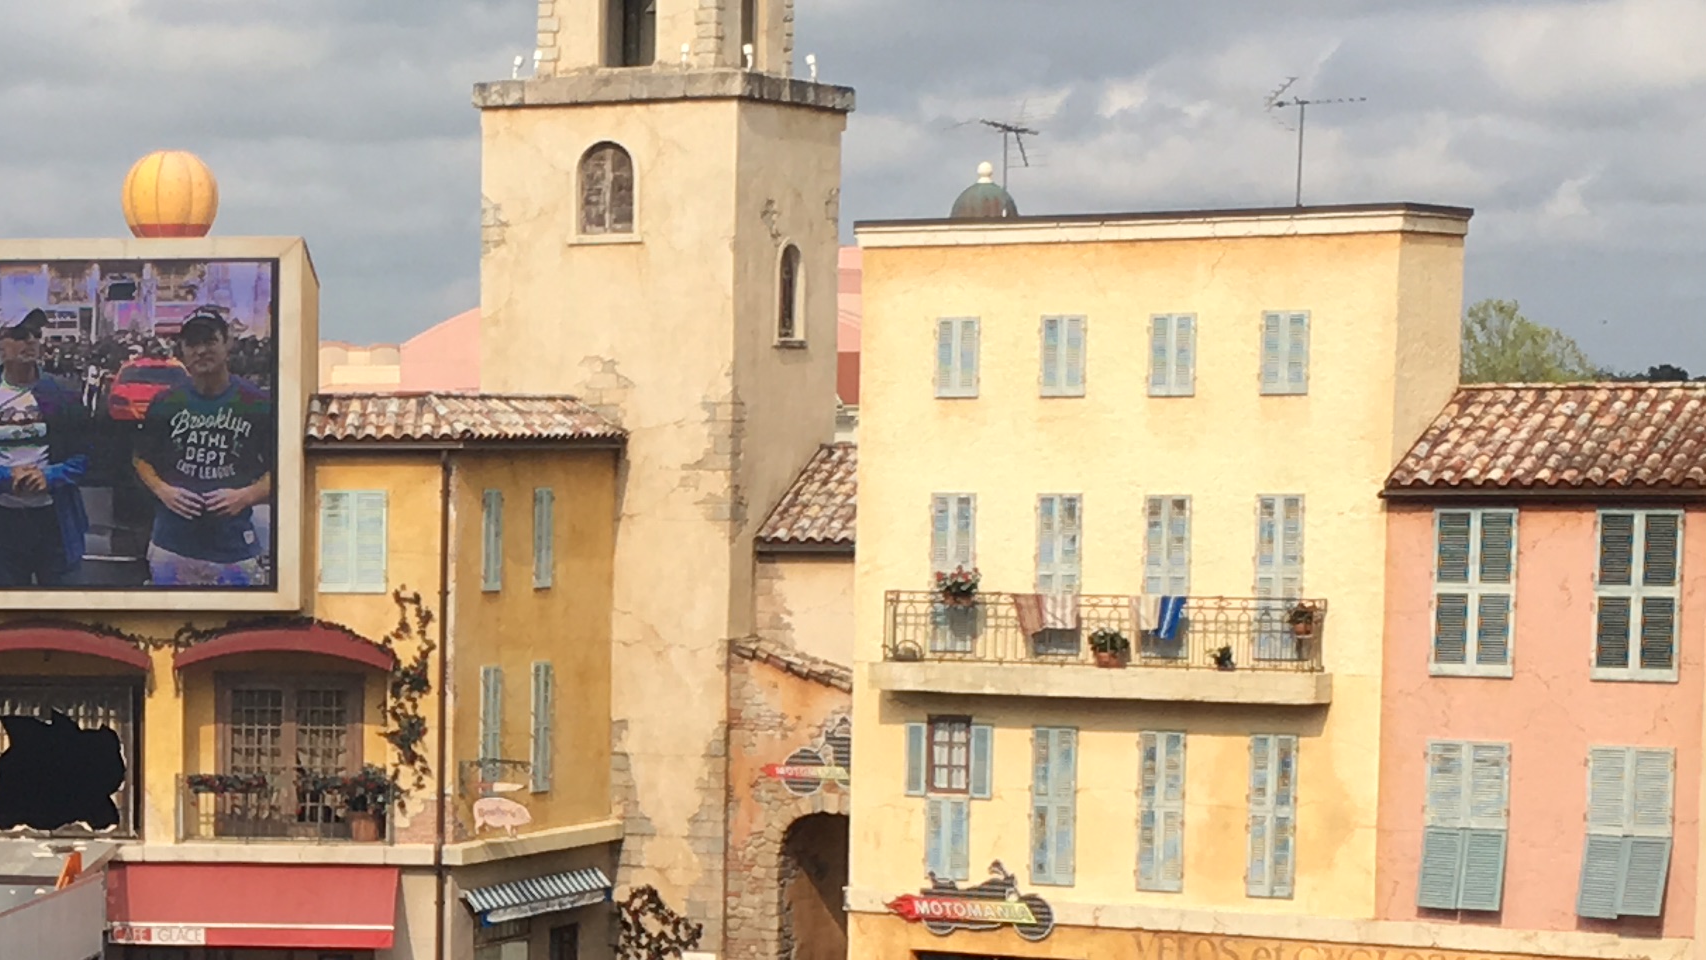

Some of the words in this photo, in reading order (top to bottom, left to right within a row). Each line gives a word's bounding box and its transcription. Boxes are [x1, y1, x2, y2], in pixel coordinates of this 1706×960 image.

[171, 407, 251, 438] Brooklyn
[187, 431, 228, 448] ATHL
[186, 447, 226, 465] DEPT
[199, 464, 236, 479] LEAGUE
[914, 900, 1032, 921] MOTOMANIA
